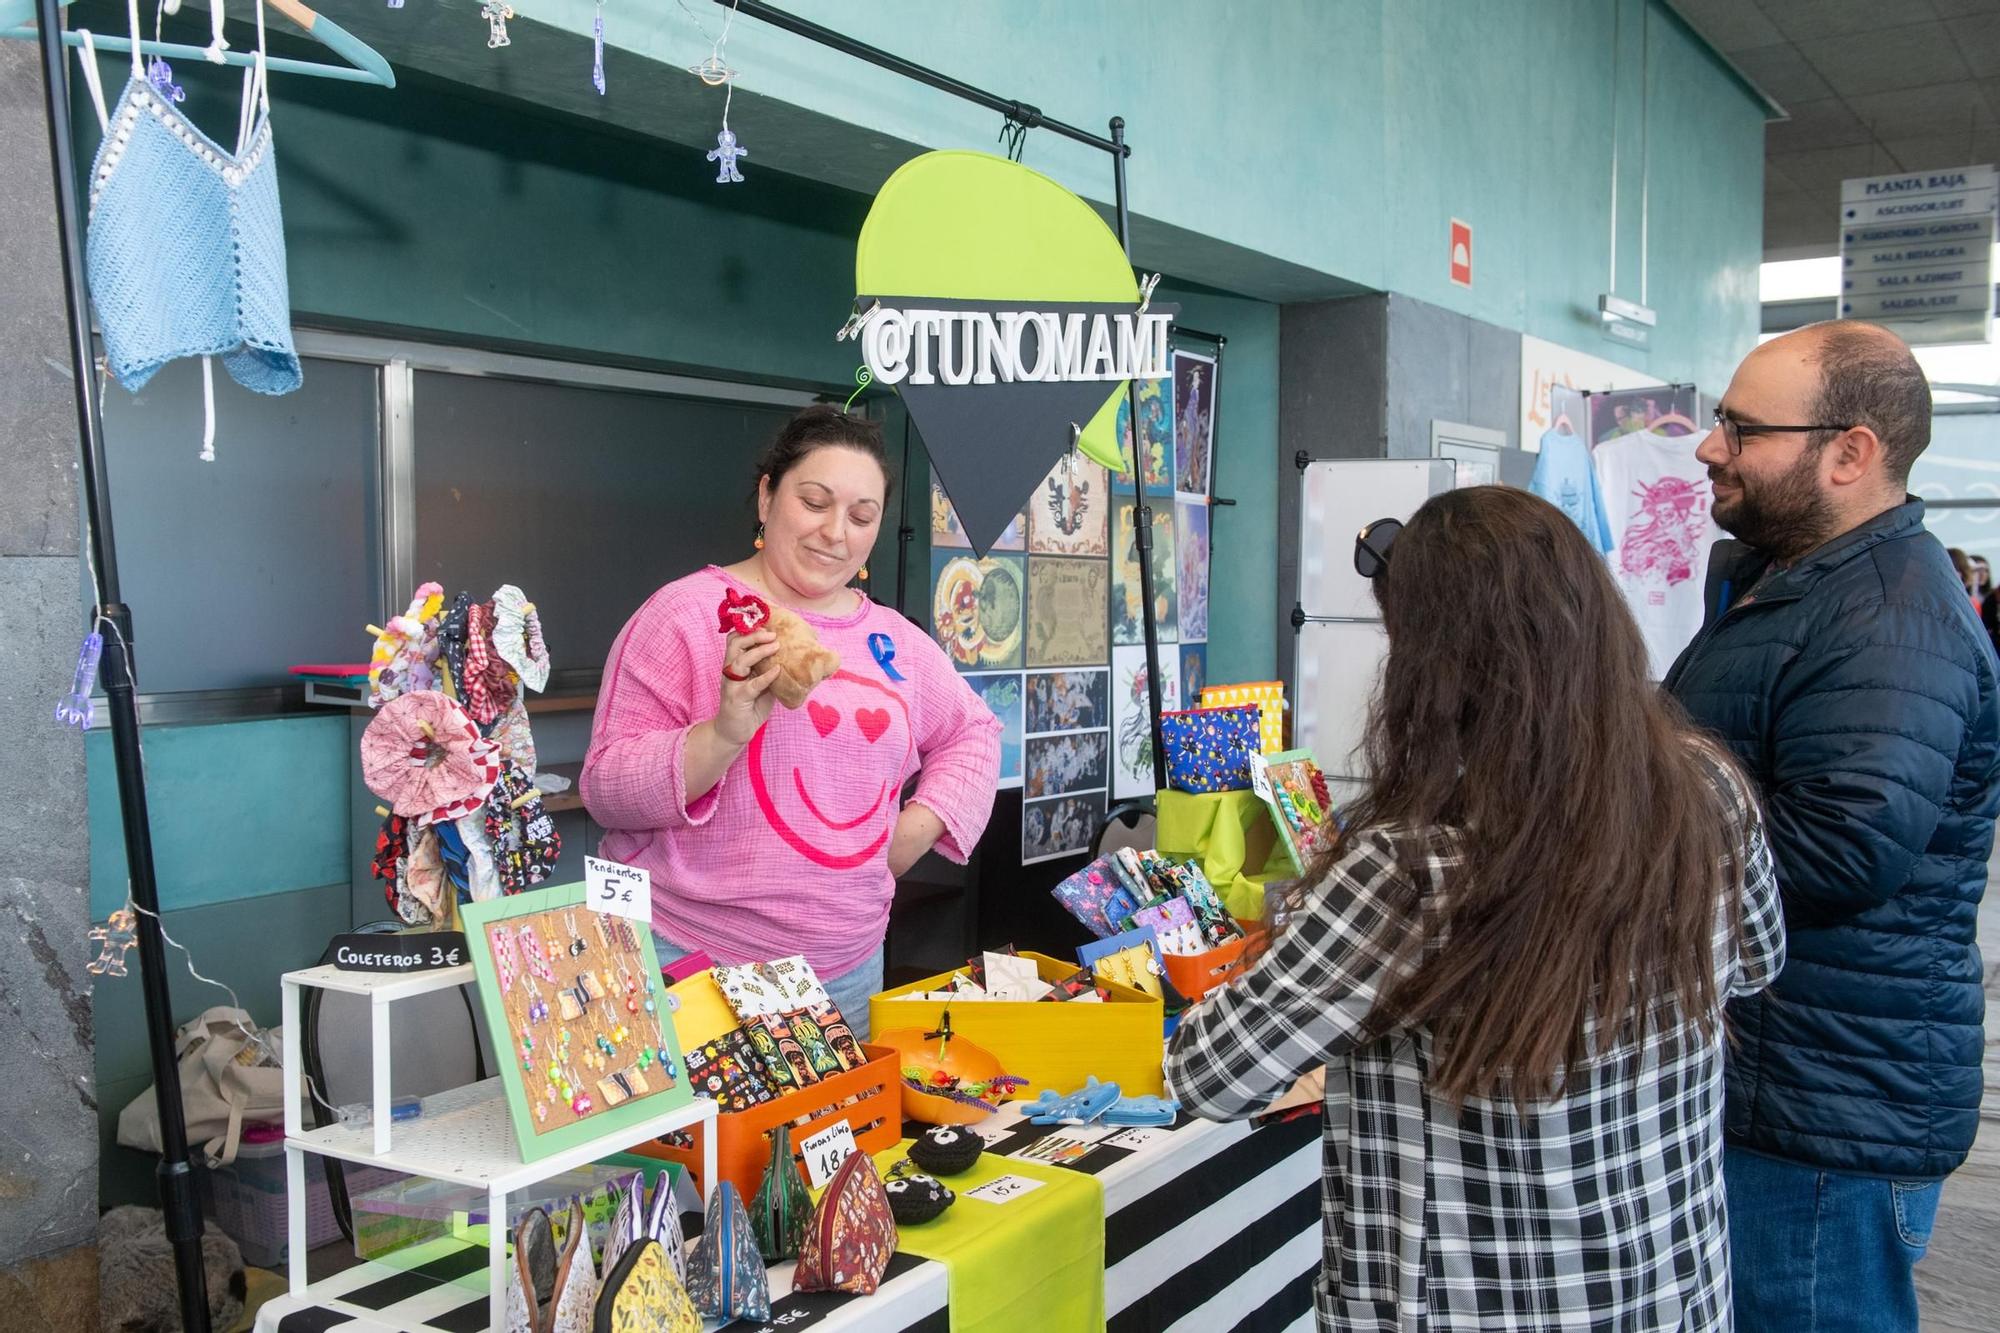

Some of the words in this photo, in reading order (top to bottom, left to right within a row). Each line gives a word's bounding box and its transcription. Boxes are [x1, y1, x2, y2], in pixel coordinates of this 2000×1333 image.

[1866, 178, 1922, 195] PLANTA
[1928, 173, 1966, 188] BAJA
[1872, 251, 1903, 263] SALA
[1877, 273, 1910, 287] SALA
[862, 308, 1173, 385] @TUNOMAMI
[588, 860, 642, 882] Pendientes
[337, 946, 423, 967] COLETEROS
[430, 946, 460, 966] 3€
[773, 1309, 810, 1325] 15€
